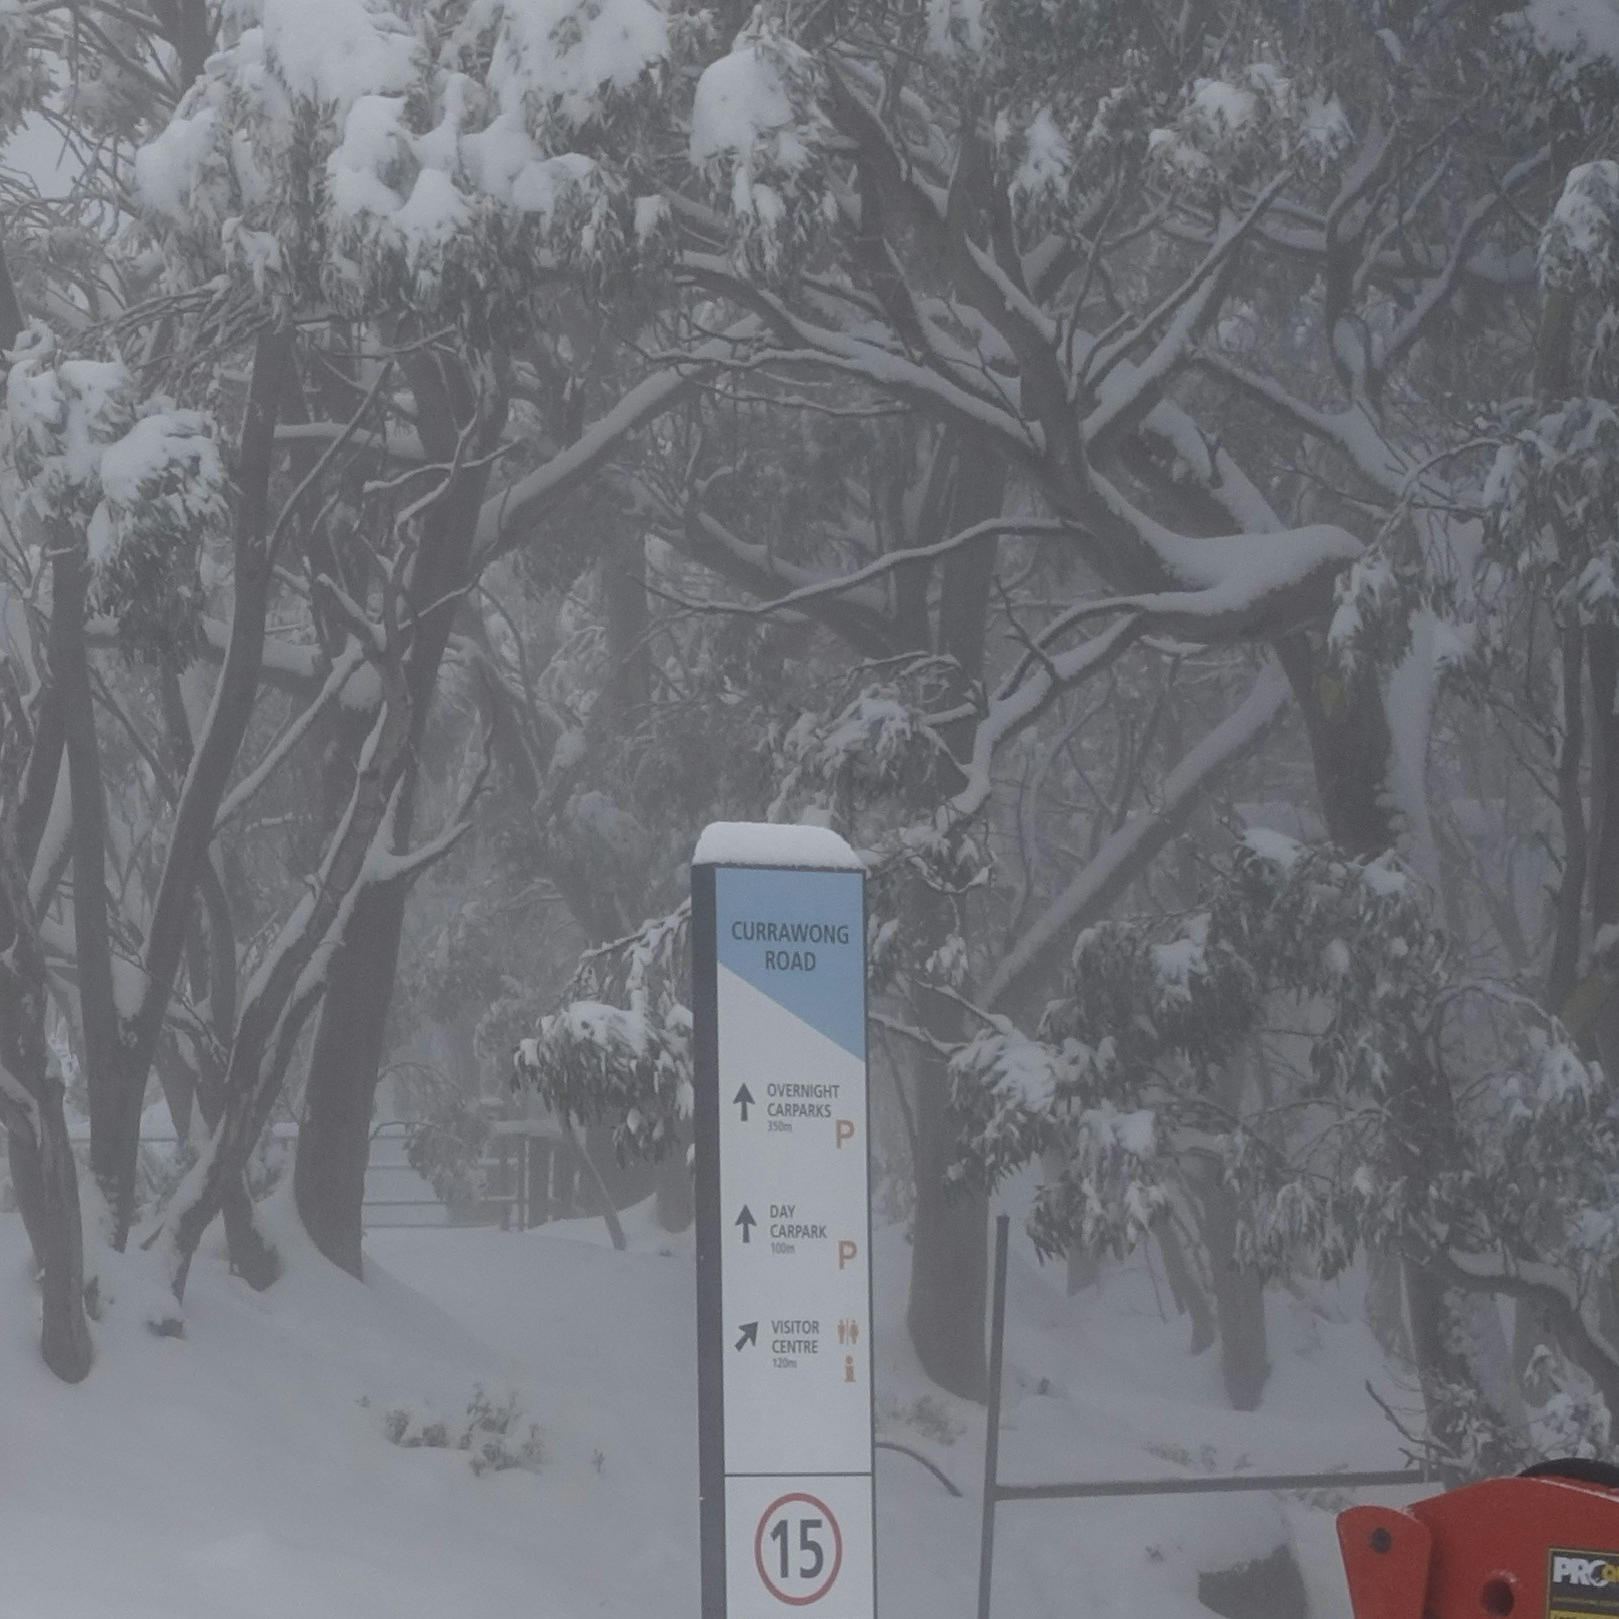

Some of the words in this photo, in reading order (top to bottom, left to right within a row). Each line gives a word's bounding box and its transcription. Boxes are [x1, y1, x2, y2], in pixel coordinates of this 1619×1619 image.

[732, 920, 849, 944] CURRAWONG
[765, 951, 817, 971] ROAD
[767, 1083, 840, 1099] OVERNIGHT
[767, 1103, 832, 1118] CARPARKS
[767, 1121, 793, 1133] 350m
[836, 1119, 855, 1149] P
[769, 1204, 796, 1219] DAY
[770, 1224, 828, 1239] CARPARK
[838, 1240, 858, 1270] P
[771, 1320, 820, 1335] VISITOR
[772, 1339, 819, 1354] CENTRE
[770, 1519, 824, 1579] 15
